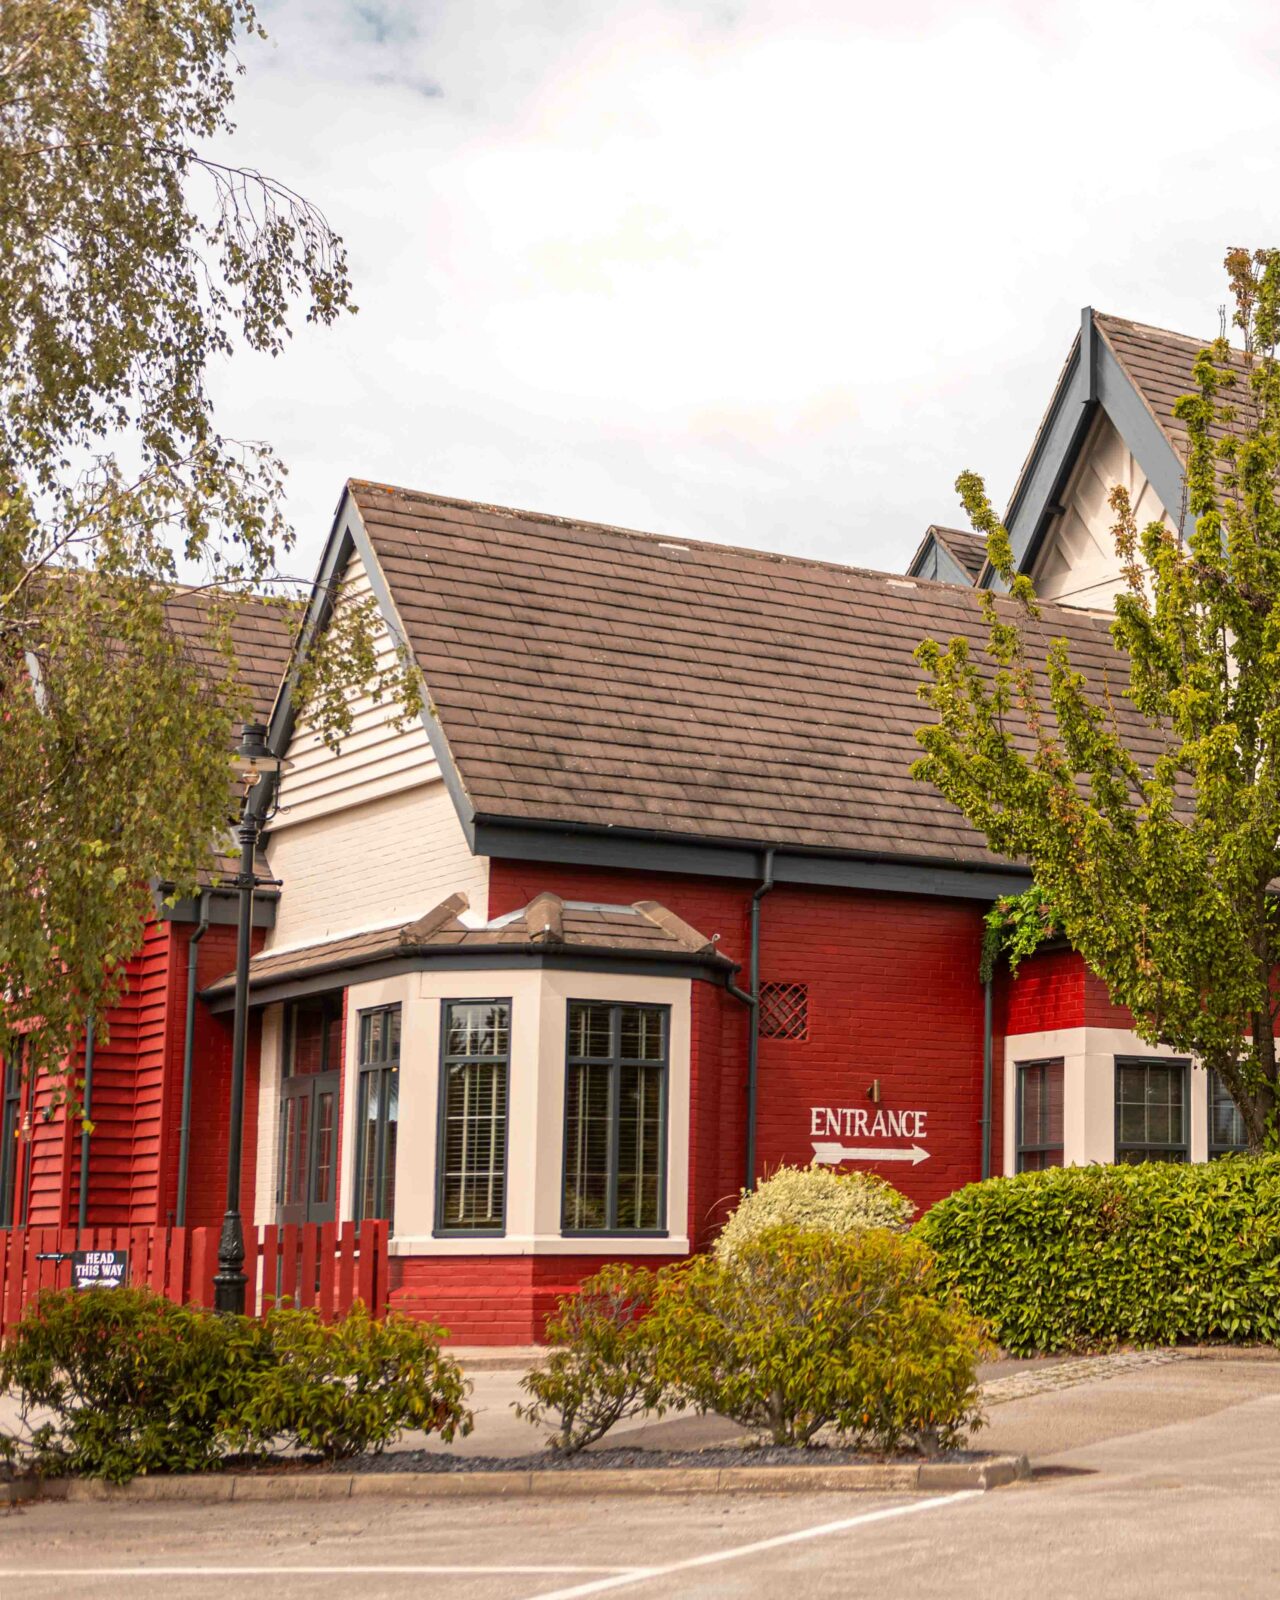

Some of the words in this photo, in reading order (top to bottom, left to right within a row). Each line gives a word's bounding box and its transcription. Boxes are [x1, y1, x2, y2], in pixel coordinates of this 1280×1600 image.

[810, 1107, 927, 1138] ENTRANCE
[86, 1252, 115, 1264] HEAD
[75, 1264, 99, 1276] THIS
[101, 1264, 124, 1276] WAY
